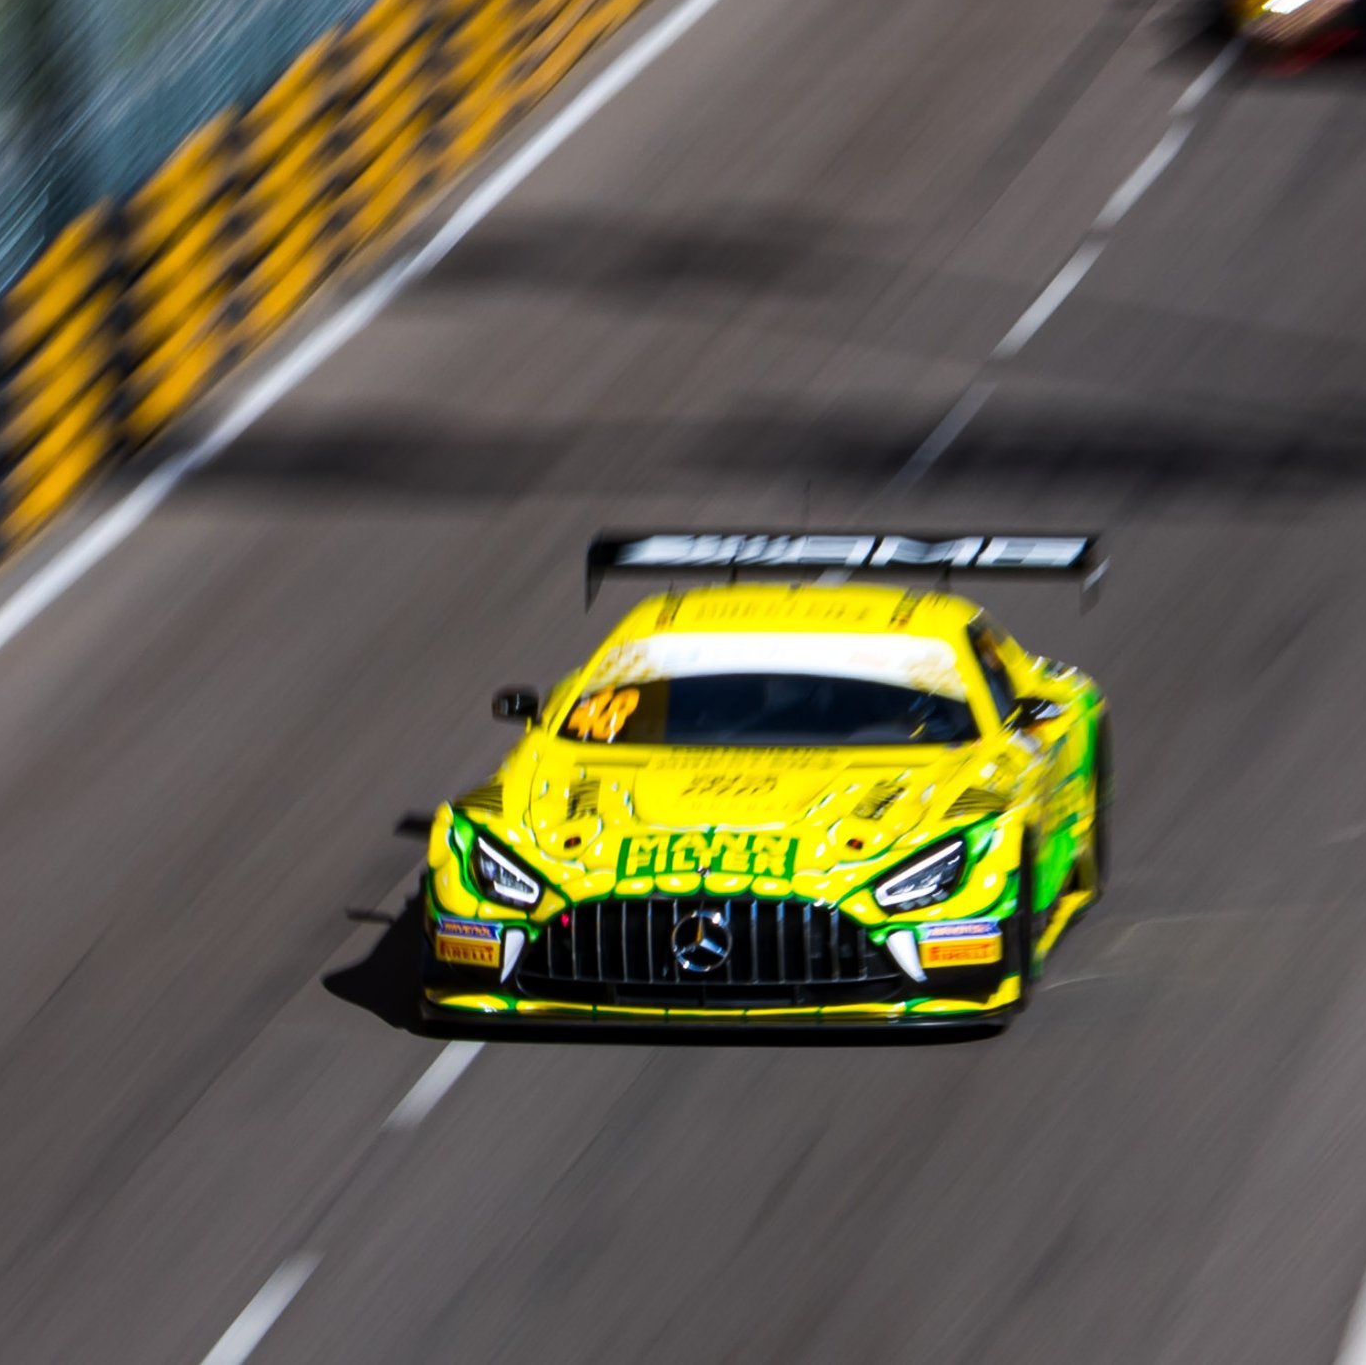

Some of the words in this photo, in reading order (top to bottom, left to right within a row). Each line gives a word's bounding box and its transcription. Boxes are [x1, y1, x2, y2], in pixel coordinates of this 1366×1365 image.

[629, 833, 792, 856] MANN
[625, 849, 787, 877] FILTER
[439, 939, 494, 962] PIRELLI
